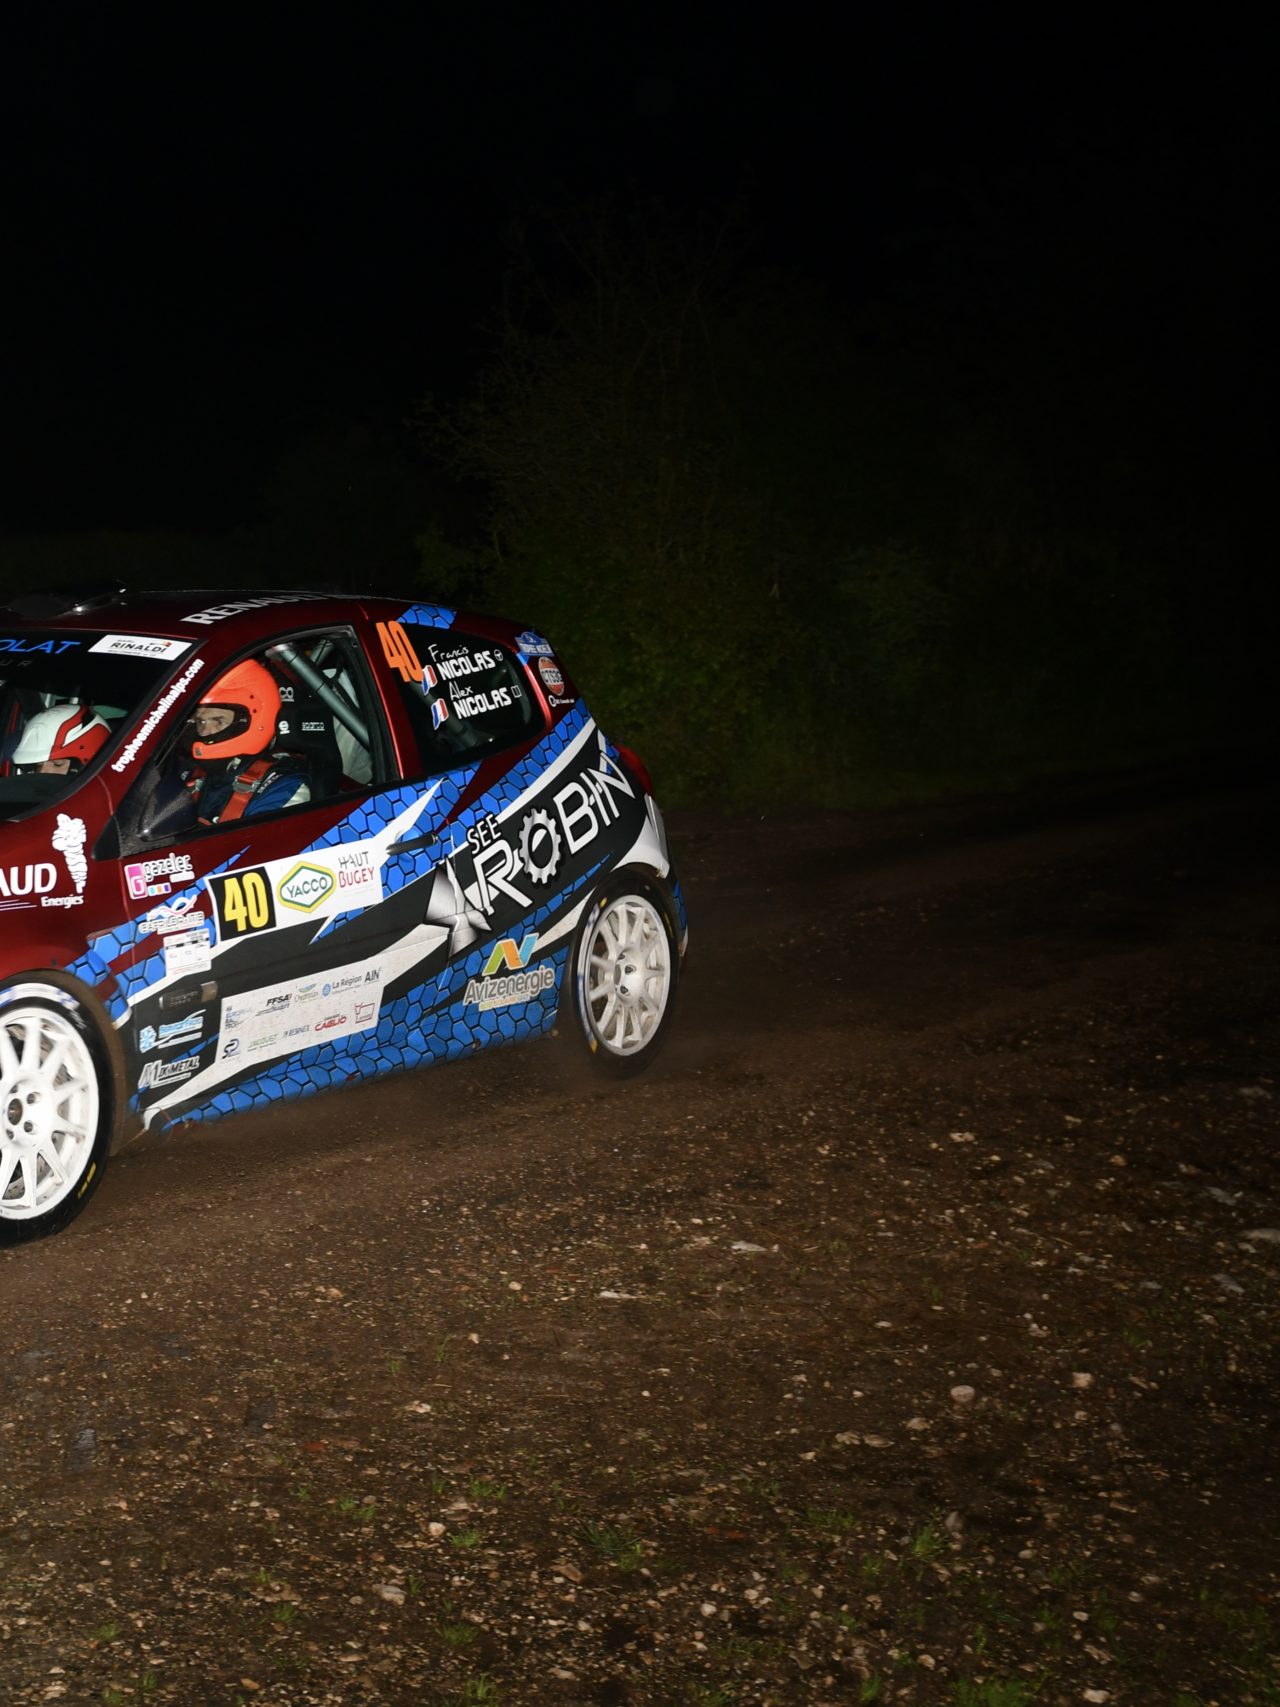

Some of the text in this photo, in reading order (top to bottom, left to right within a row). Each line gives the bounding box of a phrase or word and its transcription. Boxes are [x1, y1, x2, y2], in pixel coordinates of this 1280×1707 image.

[110, 642, 167, 653] RINALDI
[376, 620, 424, 682] 40
[428, 643, 469, 662] Francis
[436, 650, 496, 681] NICOLAS
[449, 681, 474, 700] Alex
[453, 687, 512, 719] NICOLAS
[111, 658, 205, 772] tropheemichelinalps.com
[466, 813, 501, 853] SEE
[338, 851, 369, 870] HAUT
[286, 876, 328, 898] YACCO
[338, 867, 375, 889] BUGEY
[41, 894, 84, 909] Energies
[223, 872, 270, 932] 40
[332, 982, 340, 990] La
[463, 965, 556, 1006] Avizenergie
